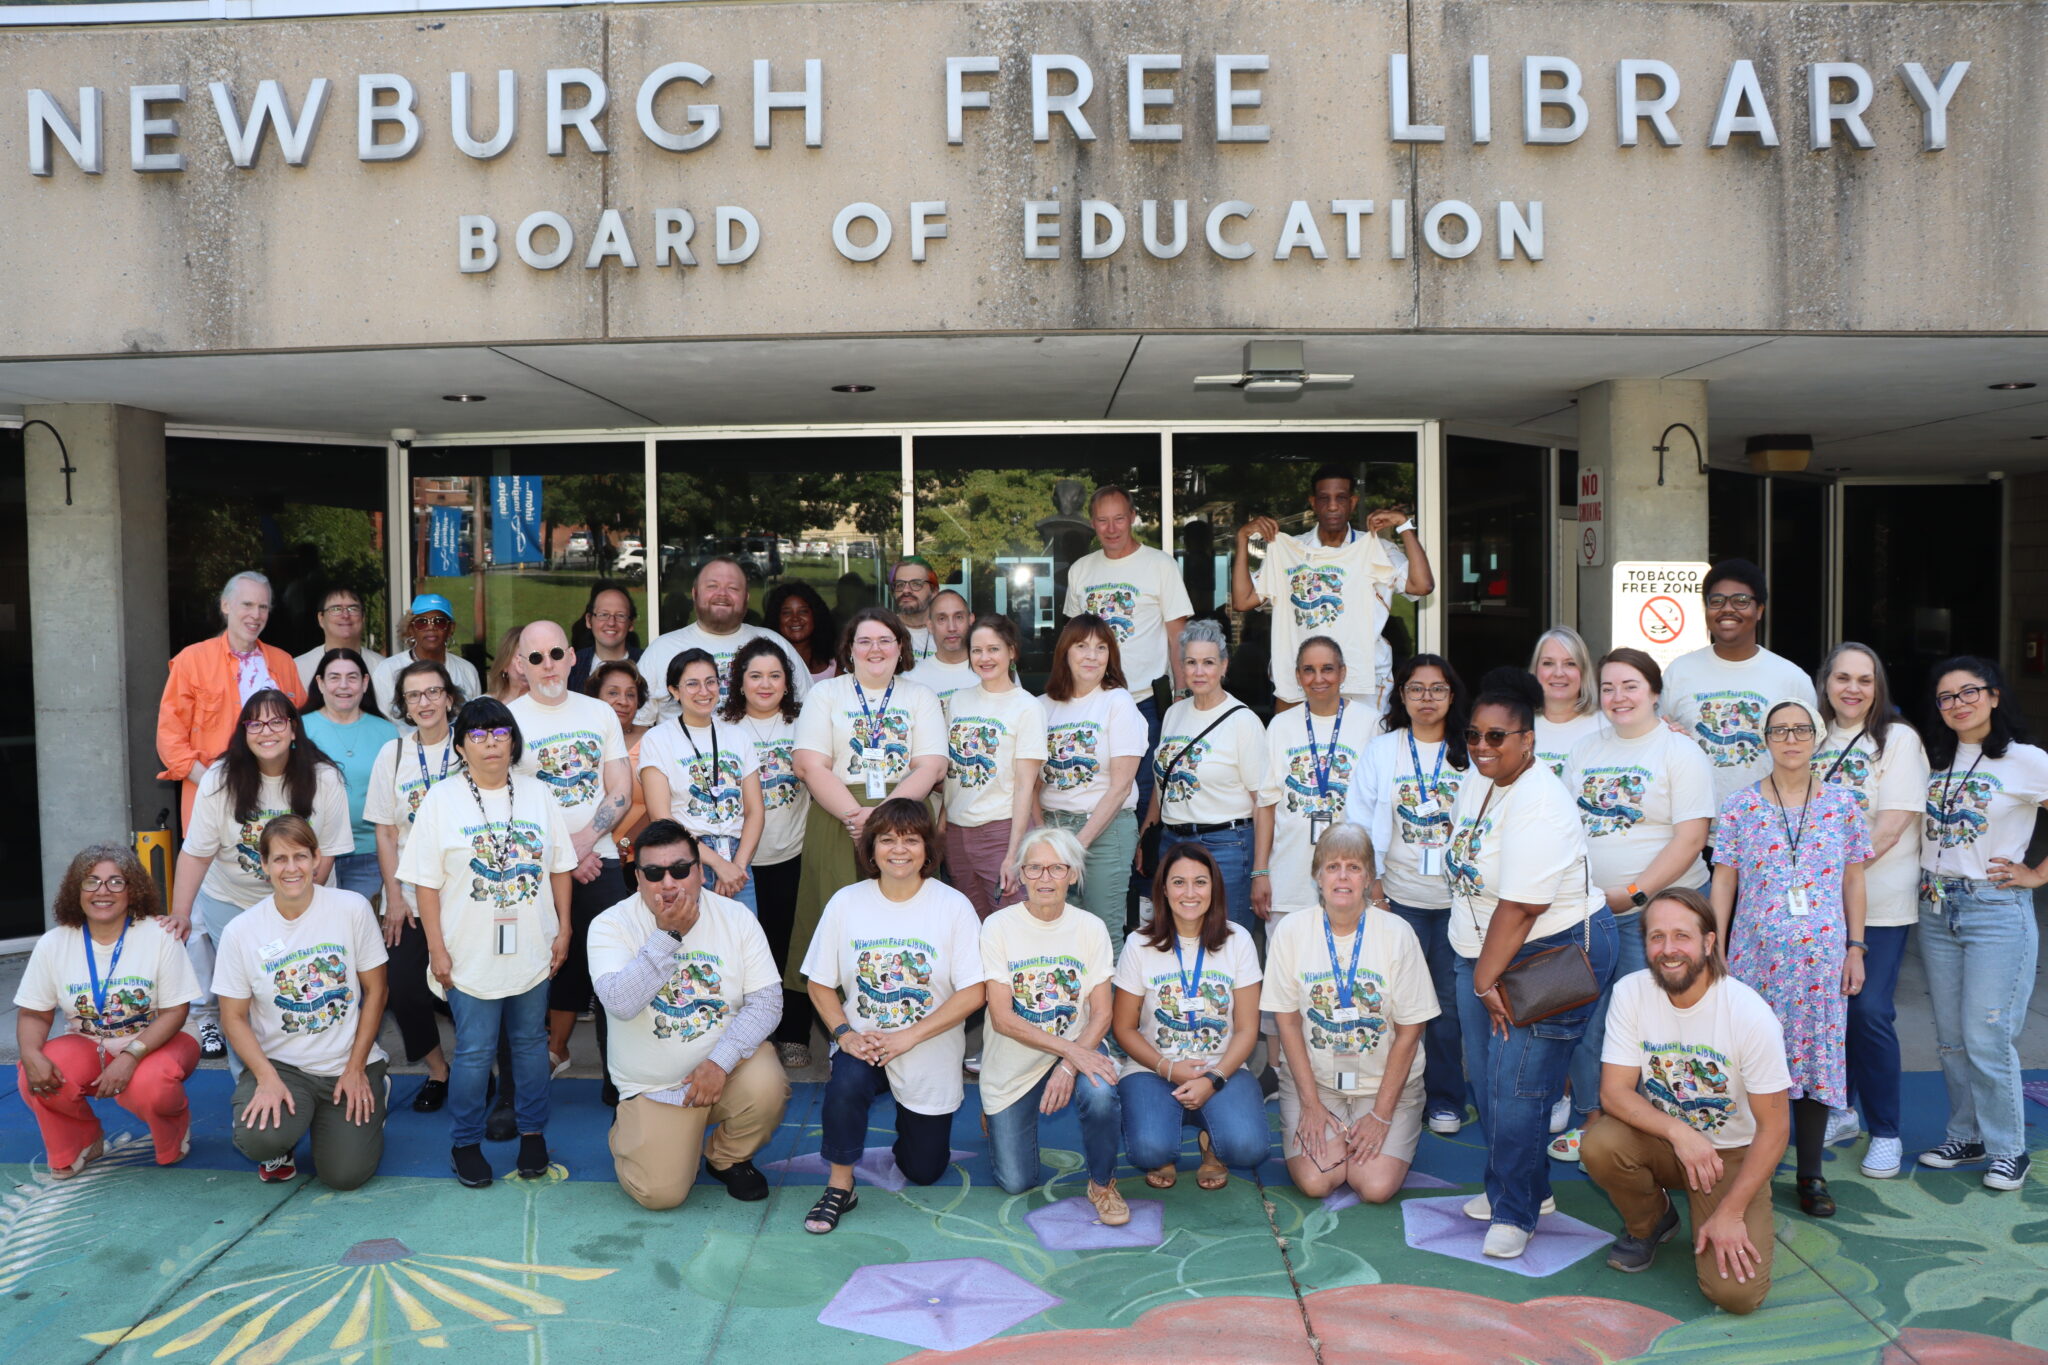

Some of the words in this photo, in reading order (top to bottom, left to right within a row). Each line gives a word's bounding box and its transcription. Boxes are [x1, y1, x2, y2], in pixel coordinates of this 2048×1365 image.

[28, 57, 823, 178] NEWBURGH
[945, 53, 1271, 147] FREE
[1389, 53, 1972, 153] LIBRARY
[457, 205, 761, 275] BOARD
[831, 201, 949, 264] OF
[1022, 196, 1545, 263] EDUCATION
[1582, 474, 1598, 497] NO
[1628, 570, 1698, 582] TOBACCO
[1622, 583, 1657, 593] FREE
[1664, 583, 1703, 594] ZONE
